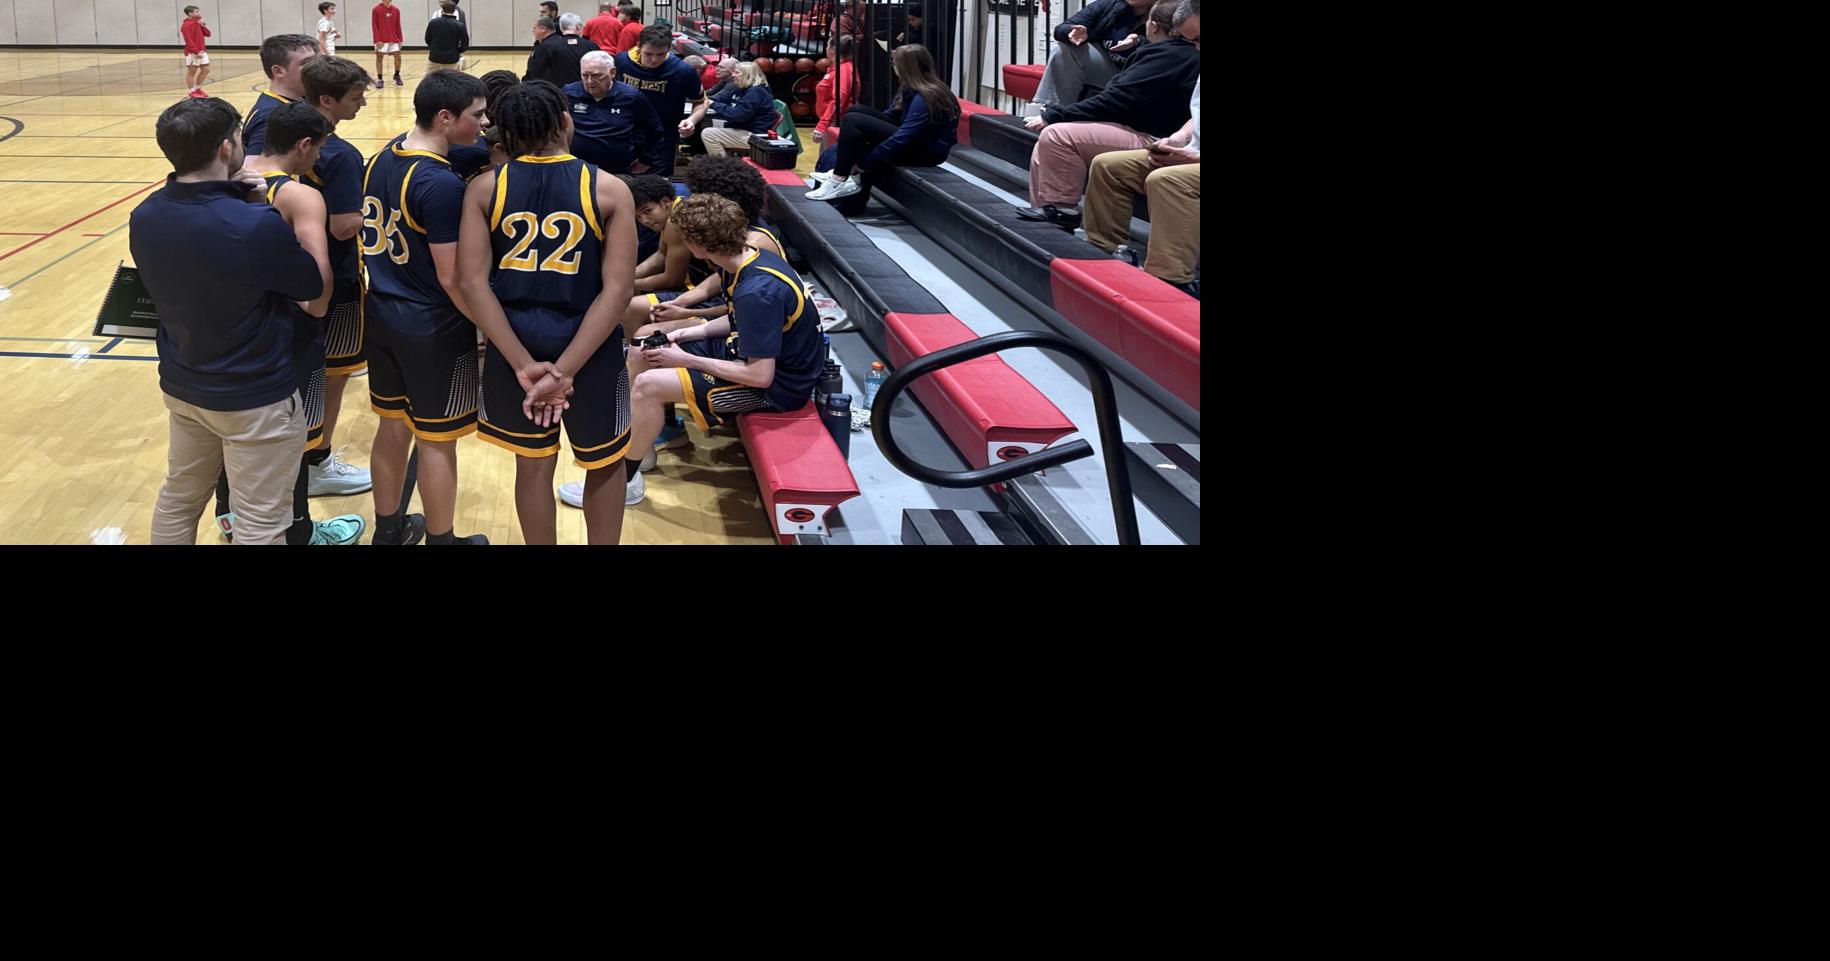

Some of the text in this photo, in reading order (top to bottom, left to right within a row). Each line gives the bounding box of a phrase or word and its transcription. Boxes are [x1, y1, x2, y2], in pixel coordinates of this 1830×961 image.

[623, 73, 641, 89] THE
[361, 196, 410, 265] 35
[499, 211, 587, 275] 22
